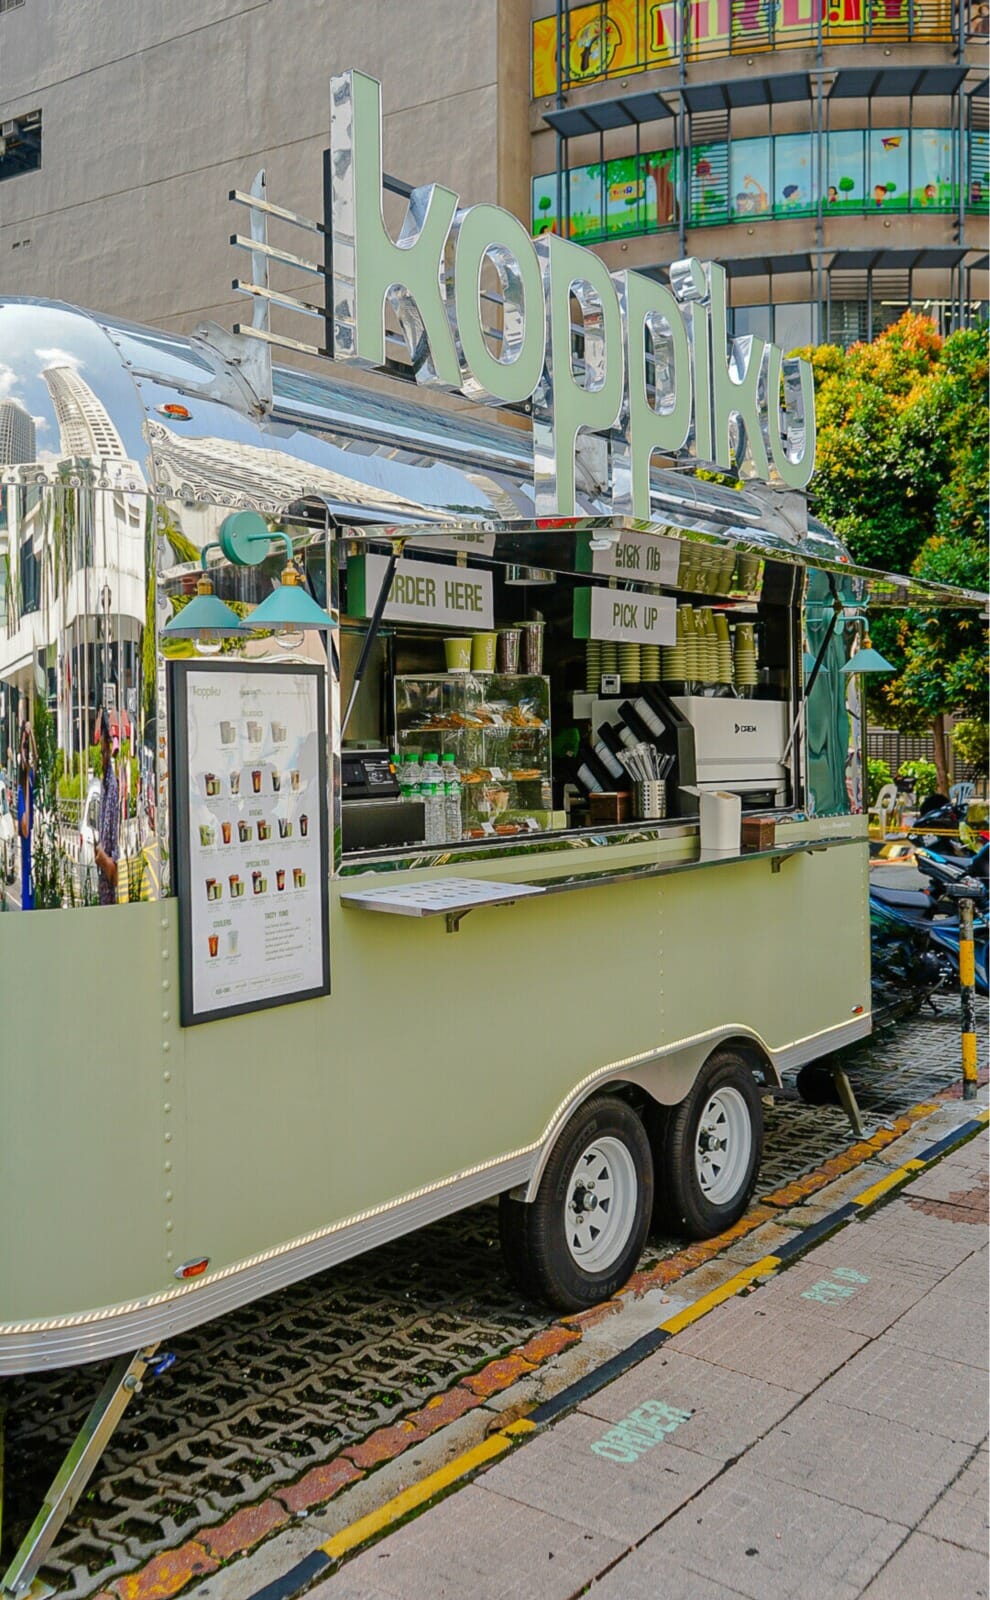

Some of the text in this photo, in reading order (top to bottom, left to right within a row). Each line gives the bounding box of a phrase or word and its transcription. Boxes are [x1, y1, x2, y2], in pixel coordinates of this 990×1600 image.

[331, 68, 816, 516] koppiku
[444, 581, 483, 612] HERE
[613, 602, 638, 629] PICK
[643, 606, 658, 630] UP
[591, 1400, 692, 1463] ORDER
